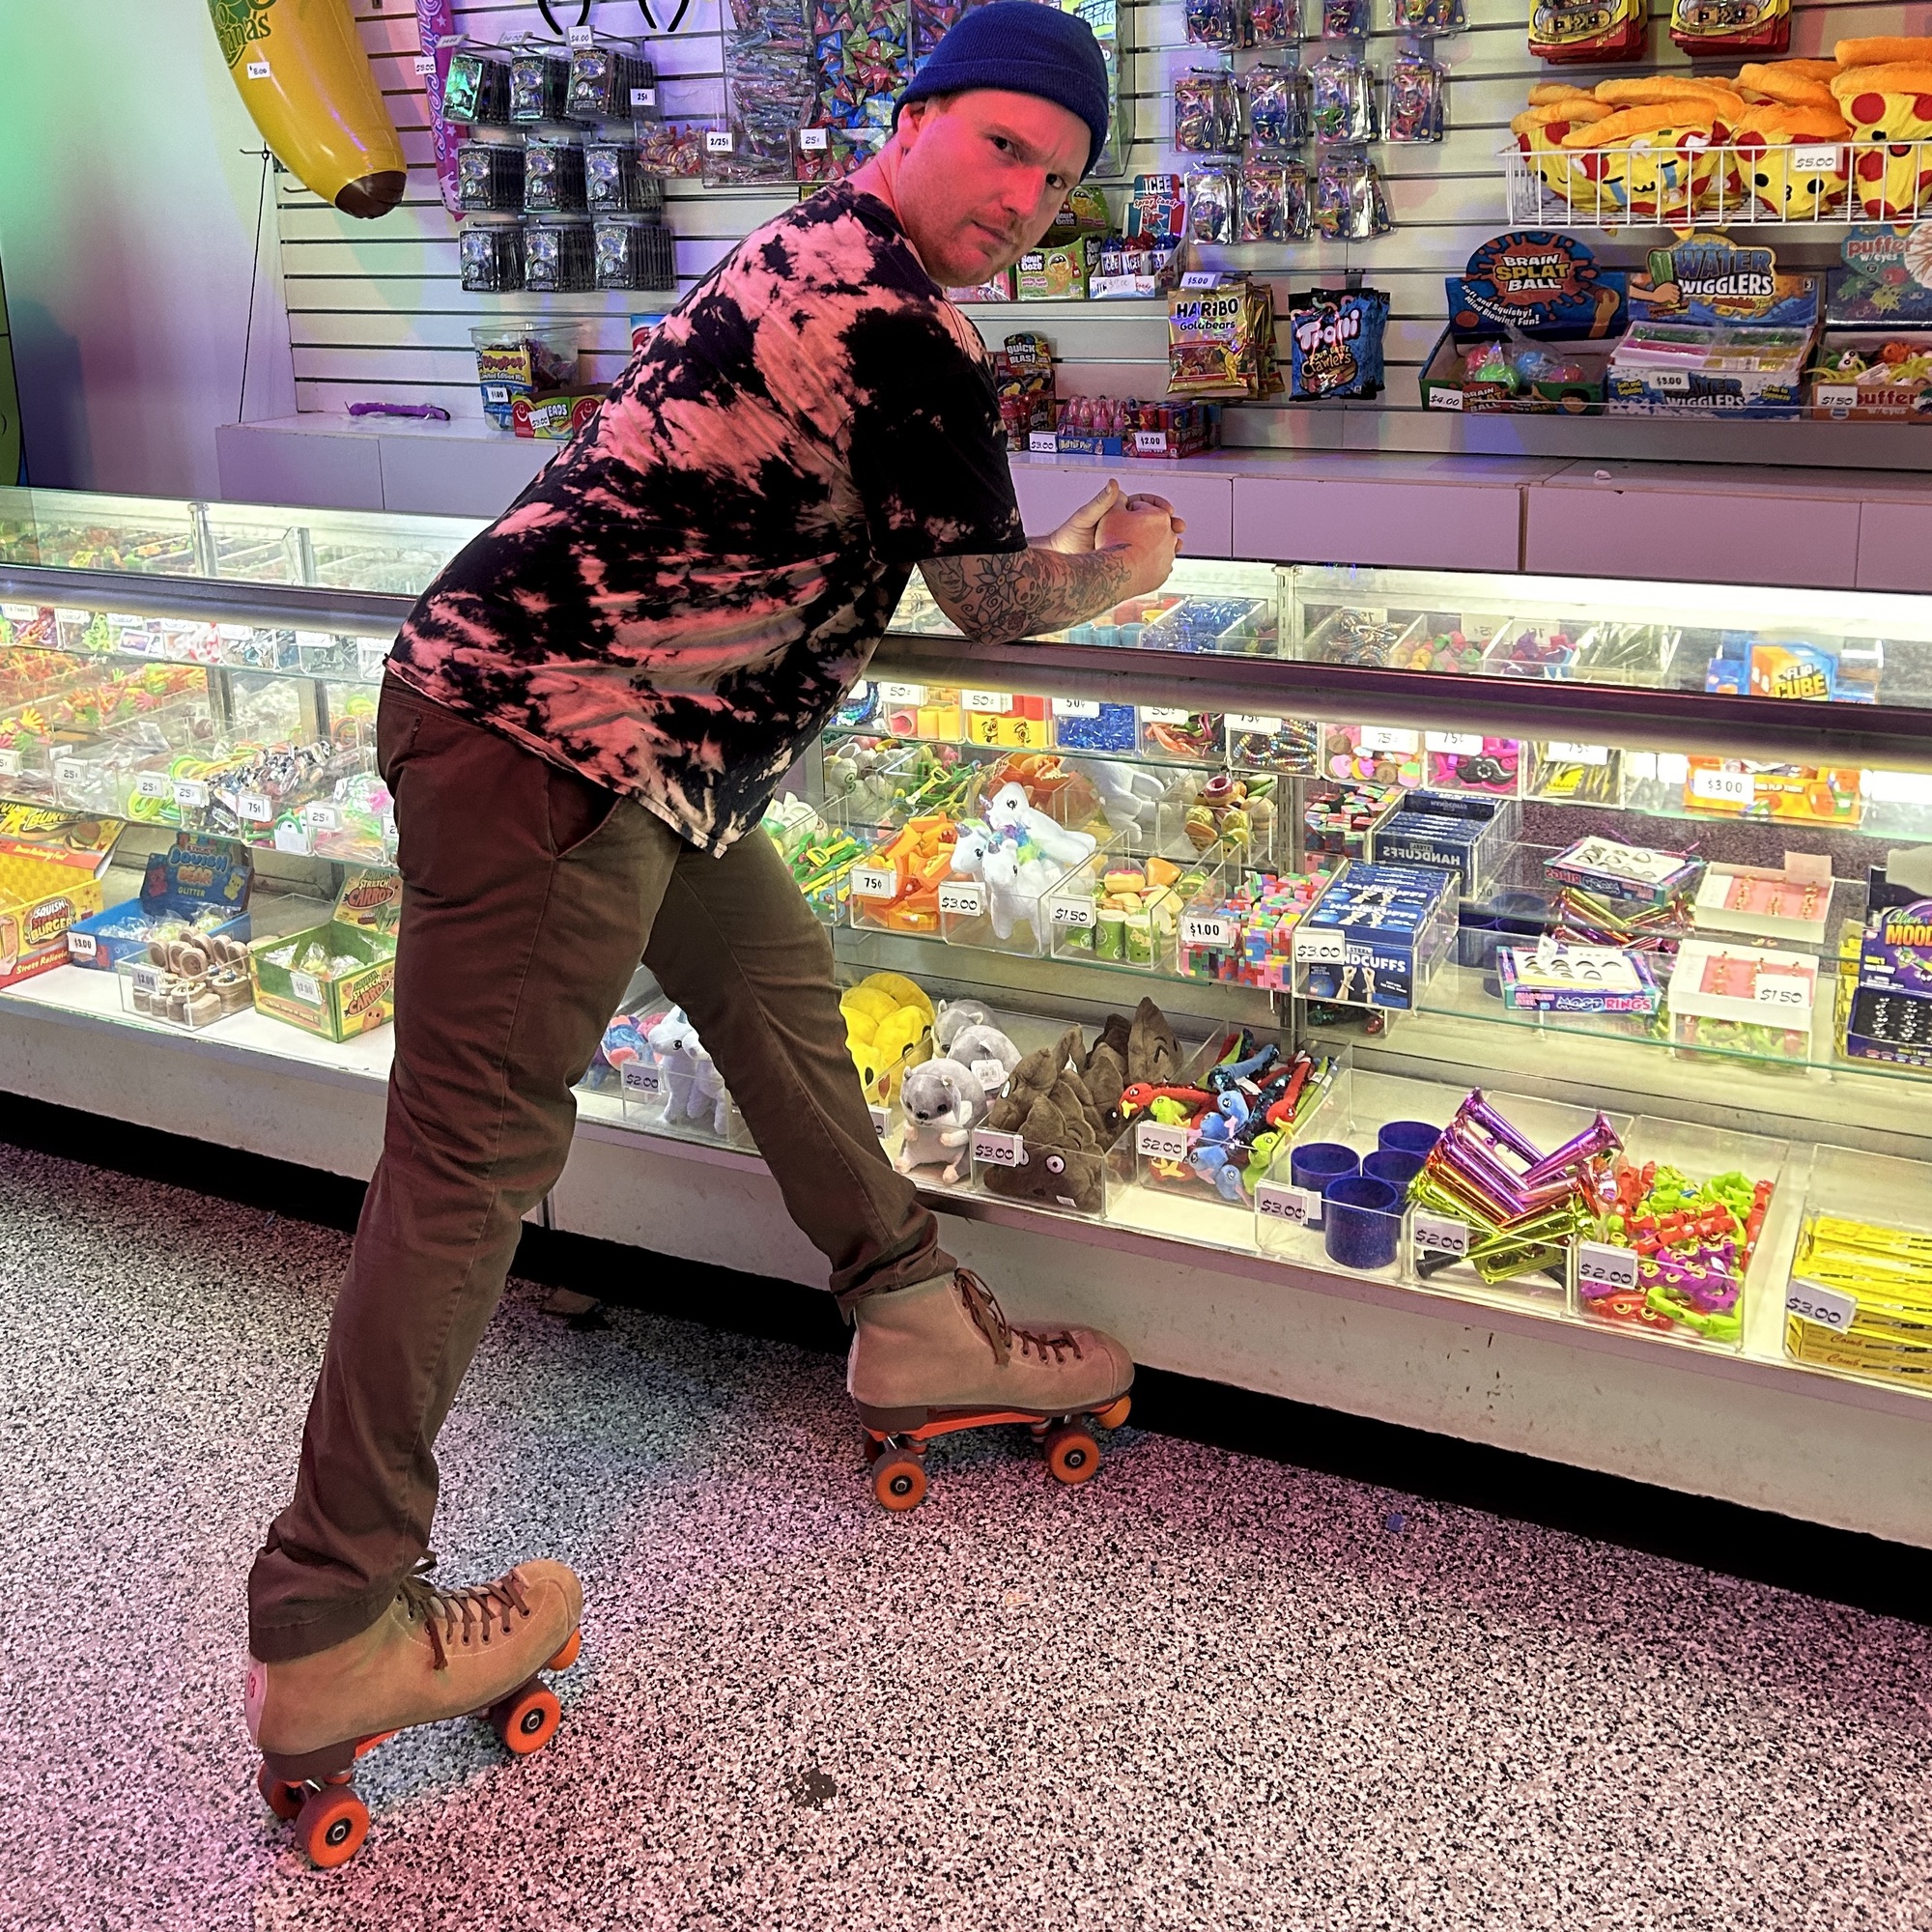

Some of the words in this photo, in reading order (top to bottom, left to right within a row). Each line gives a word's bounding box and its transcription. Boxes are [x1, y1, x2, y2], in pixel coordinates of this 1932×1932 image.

[571, 34, 590, 43] $4.00
[637, 92, 648, 100] 25¢
[1796, 157, 1834, 168] $5.00
[1143, 176, 1172, 195] ICEE
[1134, 197, 1154, 210] Spray
[1156, 196, 1181, 210] Candy
[1847, 235, 1915, 259] puffer
[1503, 254, 1560, 266] BRAIN
[1673, 249, 1773, 279] WATER
[1860, 252, 1898, 263] w/eyes
[1494, 263, 1570, 280] SPLAT
[1187, 276, 1208, 285] $5.00
[1508, 278, 1561, 293] BALL
[1678, 273, 1774, 297] WIGGLERS
[1177, 298, 1239, 320] HARIBO
[1461, 284, 1477, 298] Soft
[1476, 297, 1493, 307] and
[1492, 301, 1533, 319] Squishy!
[1464, 296, 1483, 311] Mind
[1482, 308, 1516, 326] Blowing
[1518, 314, 1540, 326] Fun!
[1297, 308, 1360, 351] Trolli
[1301, 352, 1352, 378] Crawlers
[1657, 376, 1682, 385] $3.00
[1677, 377, 1743, 397] ATER
[1463, 386, 1494, 398] BRAIN
[1470, 402, 1501, 412] BALL
[1666, 394, 1746, 410] WIGGLERS
[548, 404, 568, 417] EADS
[1031, 440, 1054, 450] $3.00
[1141, 437, 1160, 445] $2.00
[1785, 663, 1813, 680] FLIP
[1774, 674, 1827, 699] CUBE
[248, 802, 261, 813] 75¢
[312, 812, 329, 822] 25¢
[169, 847, 228, 873] SQUISH
[360, 879, 389, 890] STRETCH
[864, 877, 882, 889] 75¢
[178, 887, 205, 896] GLITTER
[349, 888, 394, 907] CARROT
[35, 899, 65, 919] SQUISH
[941, 896, 977, 911] $3.00
[1055, 908, 1088, 923] $1.50
[1886, 908, 1923, 924] Alien
[30, 918, 73, 940] BURGER
[1190, 923, 1219, 936] $1.00
[74, 938, 92, 949] $3.00
[1297, 945, 1340, 957] $3.00
[16, 959, 39, 974] Stress
[1345, 954, 1406, 973] NDCUFFS
[137, 973, 154, 985] $2.00
[354, 976, 384, 1000] STRETCH
[1605, 996, 1652, 1011] RINGS
[626, 1073, 658, 1089] $2.00
[976, 1144, 1014, 1160] $3.00
[1142, 1137, 1182, 1153] $2.00
[1261, 1199, 1306, 1219] $3.00
[1416, 1229, 1463, 1250] $2.00
[1580, 1263, 1633, 1284] $2.00
[1786, 1297, 1841, 1323] $3.00
[1830, 1333, 1864, 1348] Comb
[1827, 1353, 1861, 1367] Comb
